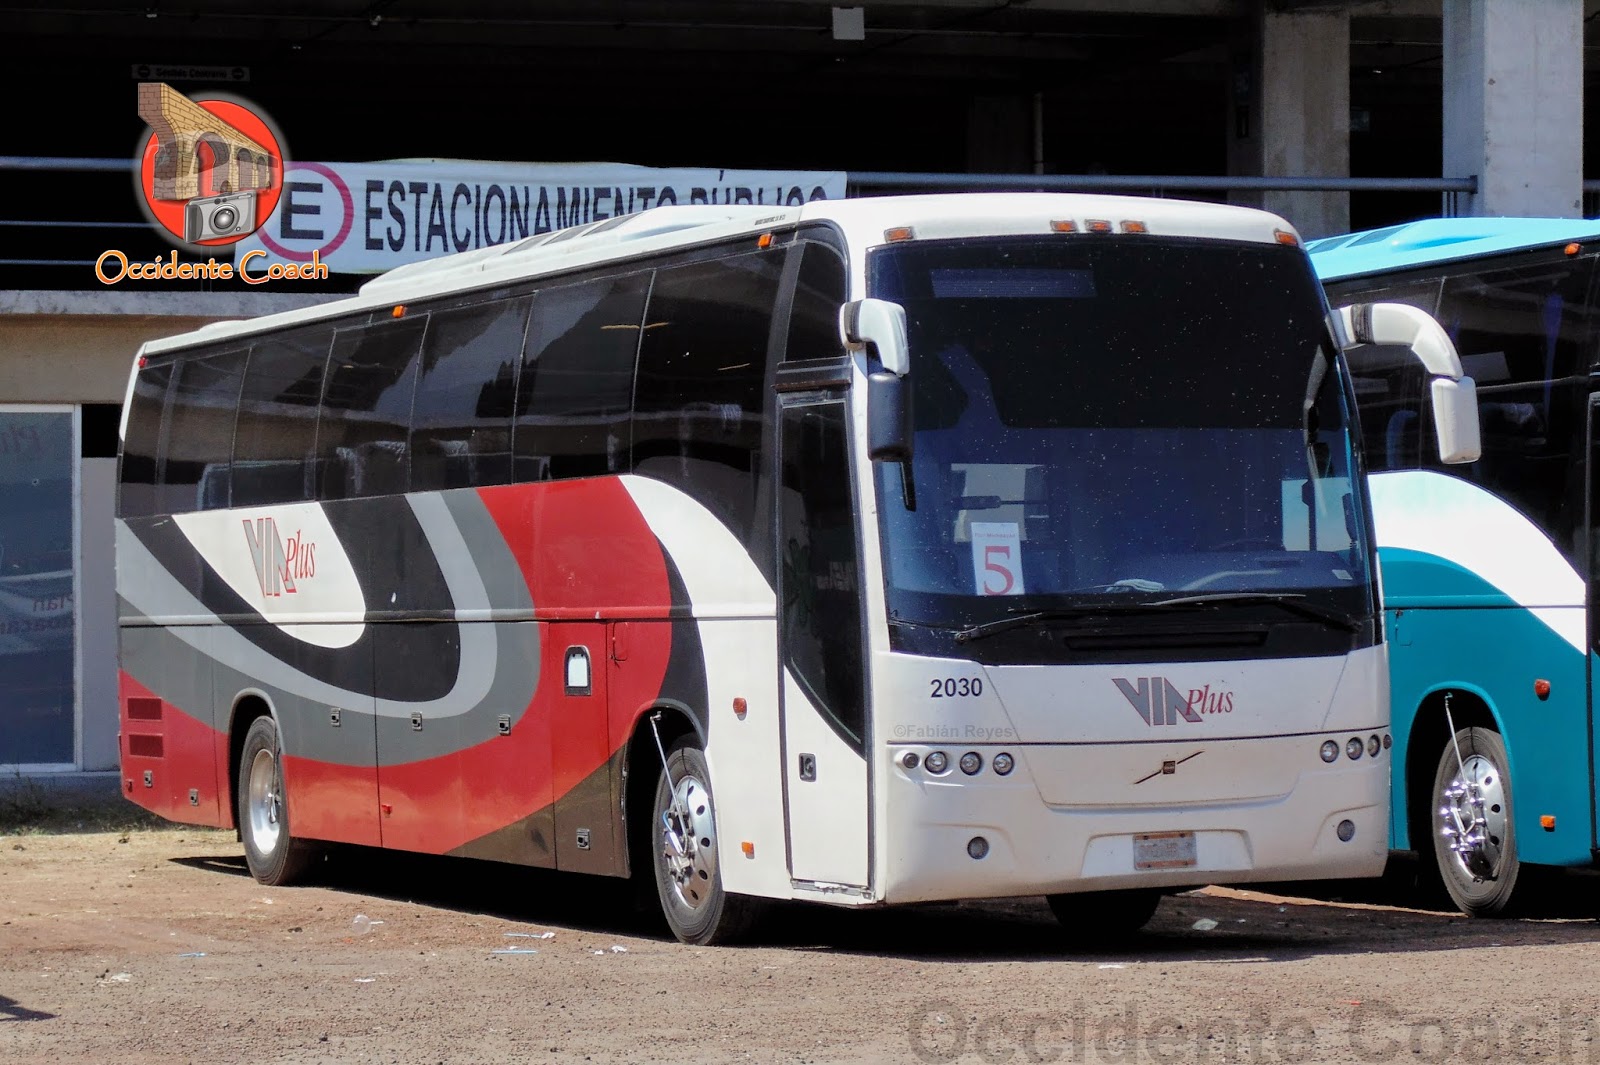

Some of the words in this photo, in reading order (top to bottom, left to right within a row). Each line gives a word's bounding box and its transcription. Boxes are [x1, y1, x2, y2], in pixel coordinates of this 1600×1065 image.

[281, 181, 325, 240] E
[284, 529, 316, 582] Plus
[983, 545, 1015, 596] 5
[930, 677, 983, 698] 2030
[1185, 684, 1234, 716] Plus
